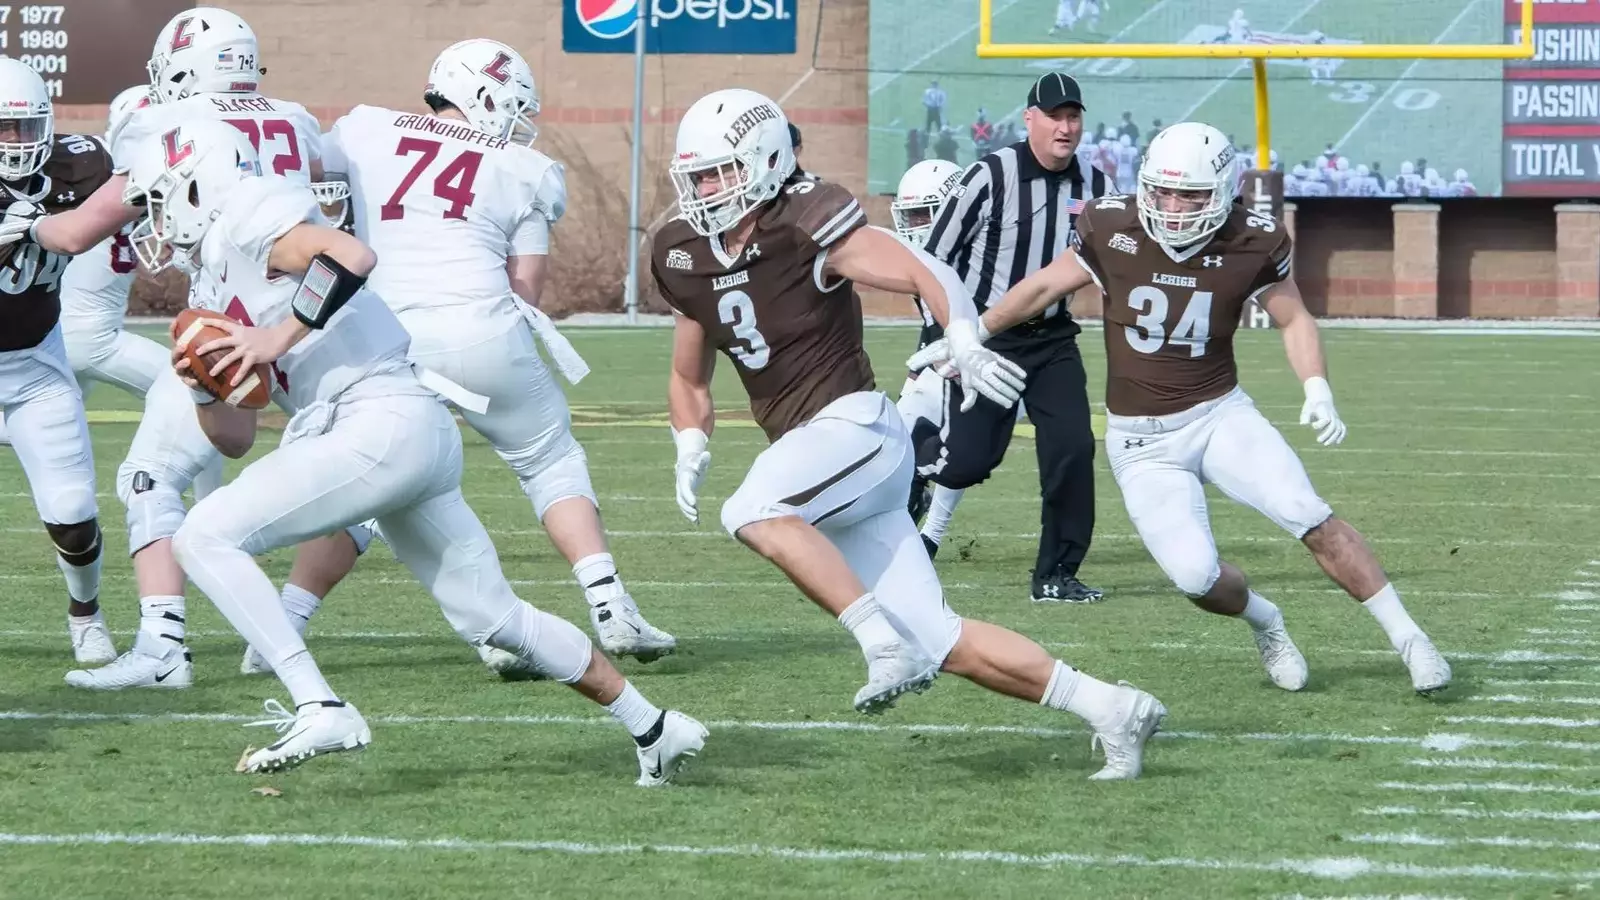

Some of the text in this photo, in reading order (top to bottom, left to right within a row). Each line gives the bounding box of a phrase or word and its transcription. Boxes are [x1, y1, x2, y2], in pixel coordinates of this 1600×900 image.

[19, 6, 65, 24] 1977
[650, 0, 786, 28] pepsi
[19, 30, 68, 49] 1980
[172, 17, 195, 52] L
[481, 51, 512, 85] L
[210, 97, 276, 111] SLATER
[1513, 85, 1600, 117] PASSIN
[393, 115, 509, 150] GRUNDHOFFER
[723, 104, 780, 149] LEHIGH
[162, 127, 195, 168] L
[1511, 144, 1585, 176] TOTAL
[380, 136, 484, 222] 74
[712, 270, 749, 290] LEHIGH
[1151, 272, 1197, 288] LEHIGH
[718, 290, 770, 369] 3
[1124, 286, 1213, 357] 34
